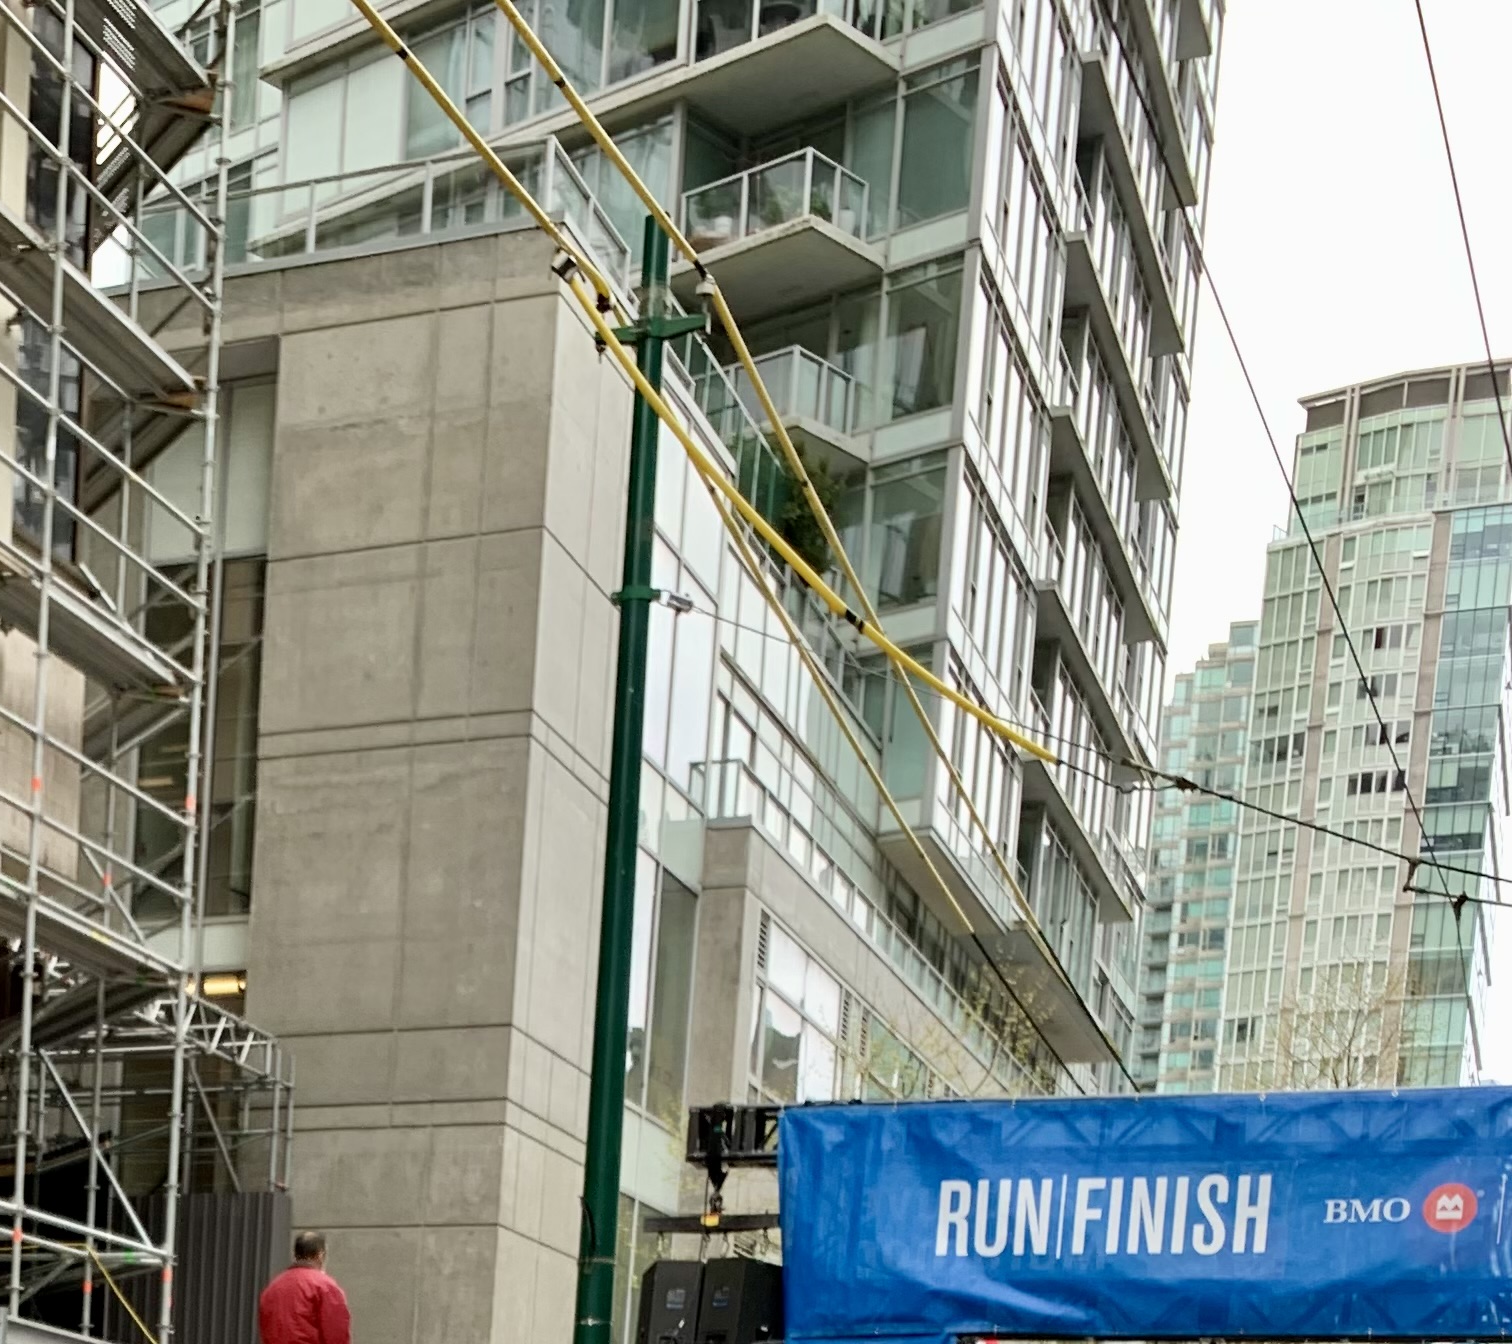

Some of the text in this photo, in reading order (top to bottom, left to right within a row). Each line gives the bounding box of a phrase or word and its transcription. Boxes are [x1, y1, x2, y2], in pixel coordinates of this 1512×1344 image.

[935, 1173, 1272, 1258] RUN FINISH
[1323, 1197, 1411, 1225] BMO
